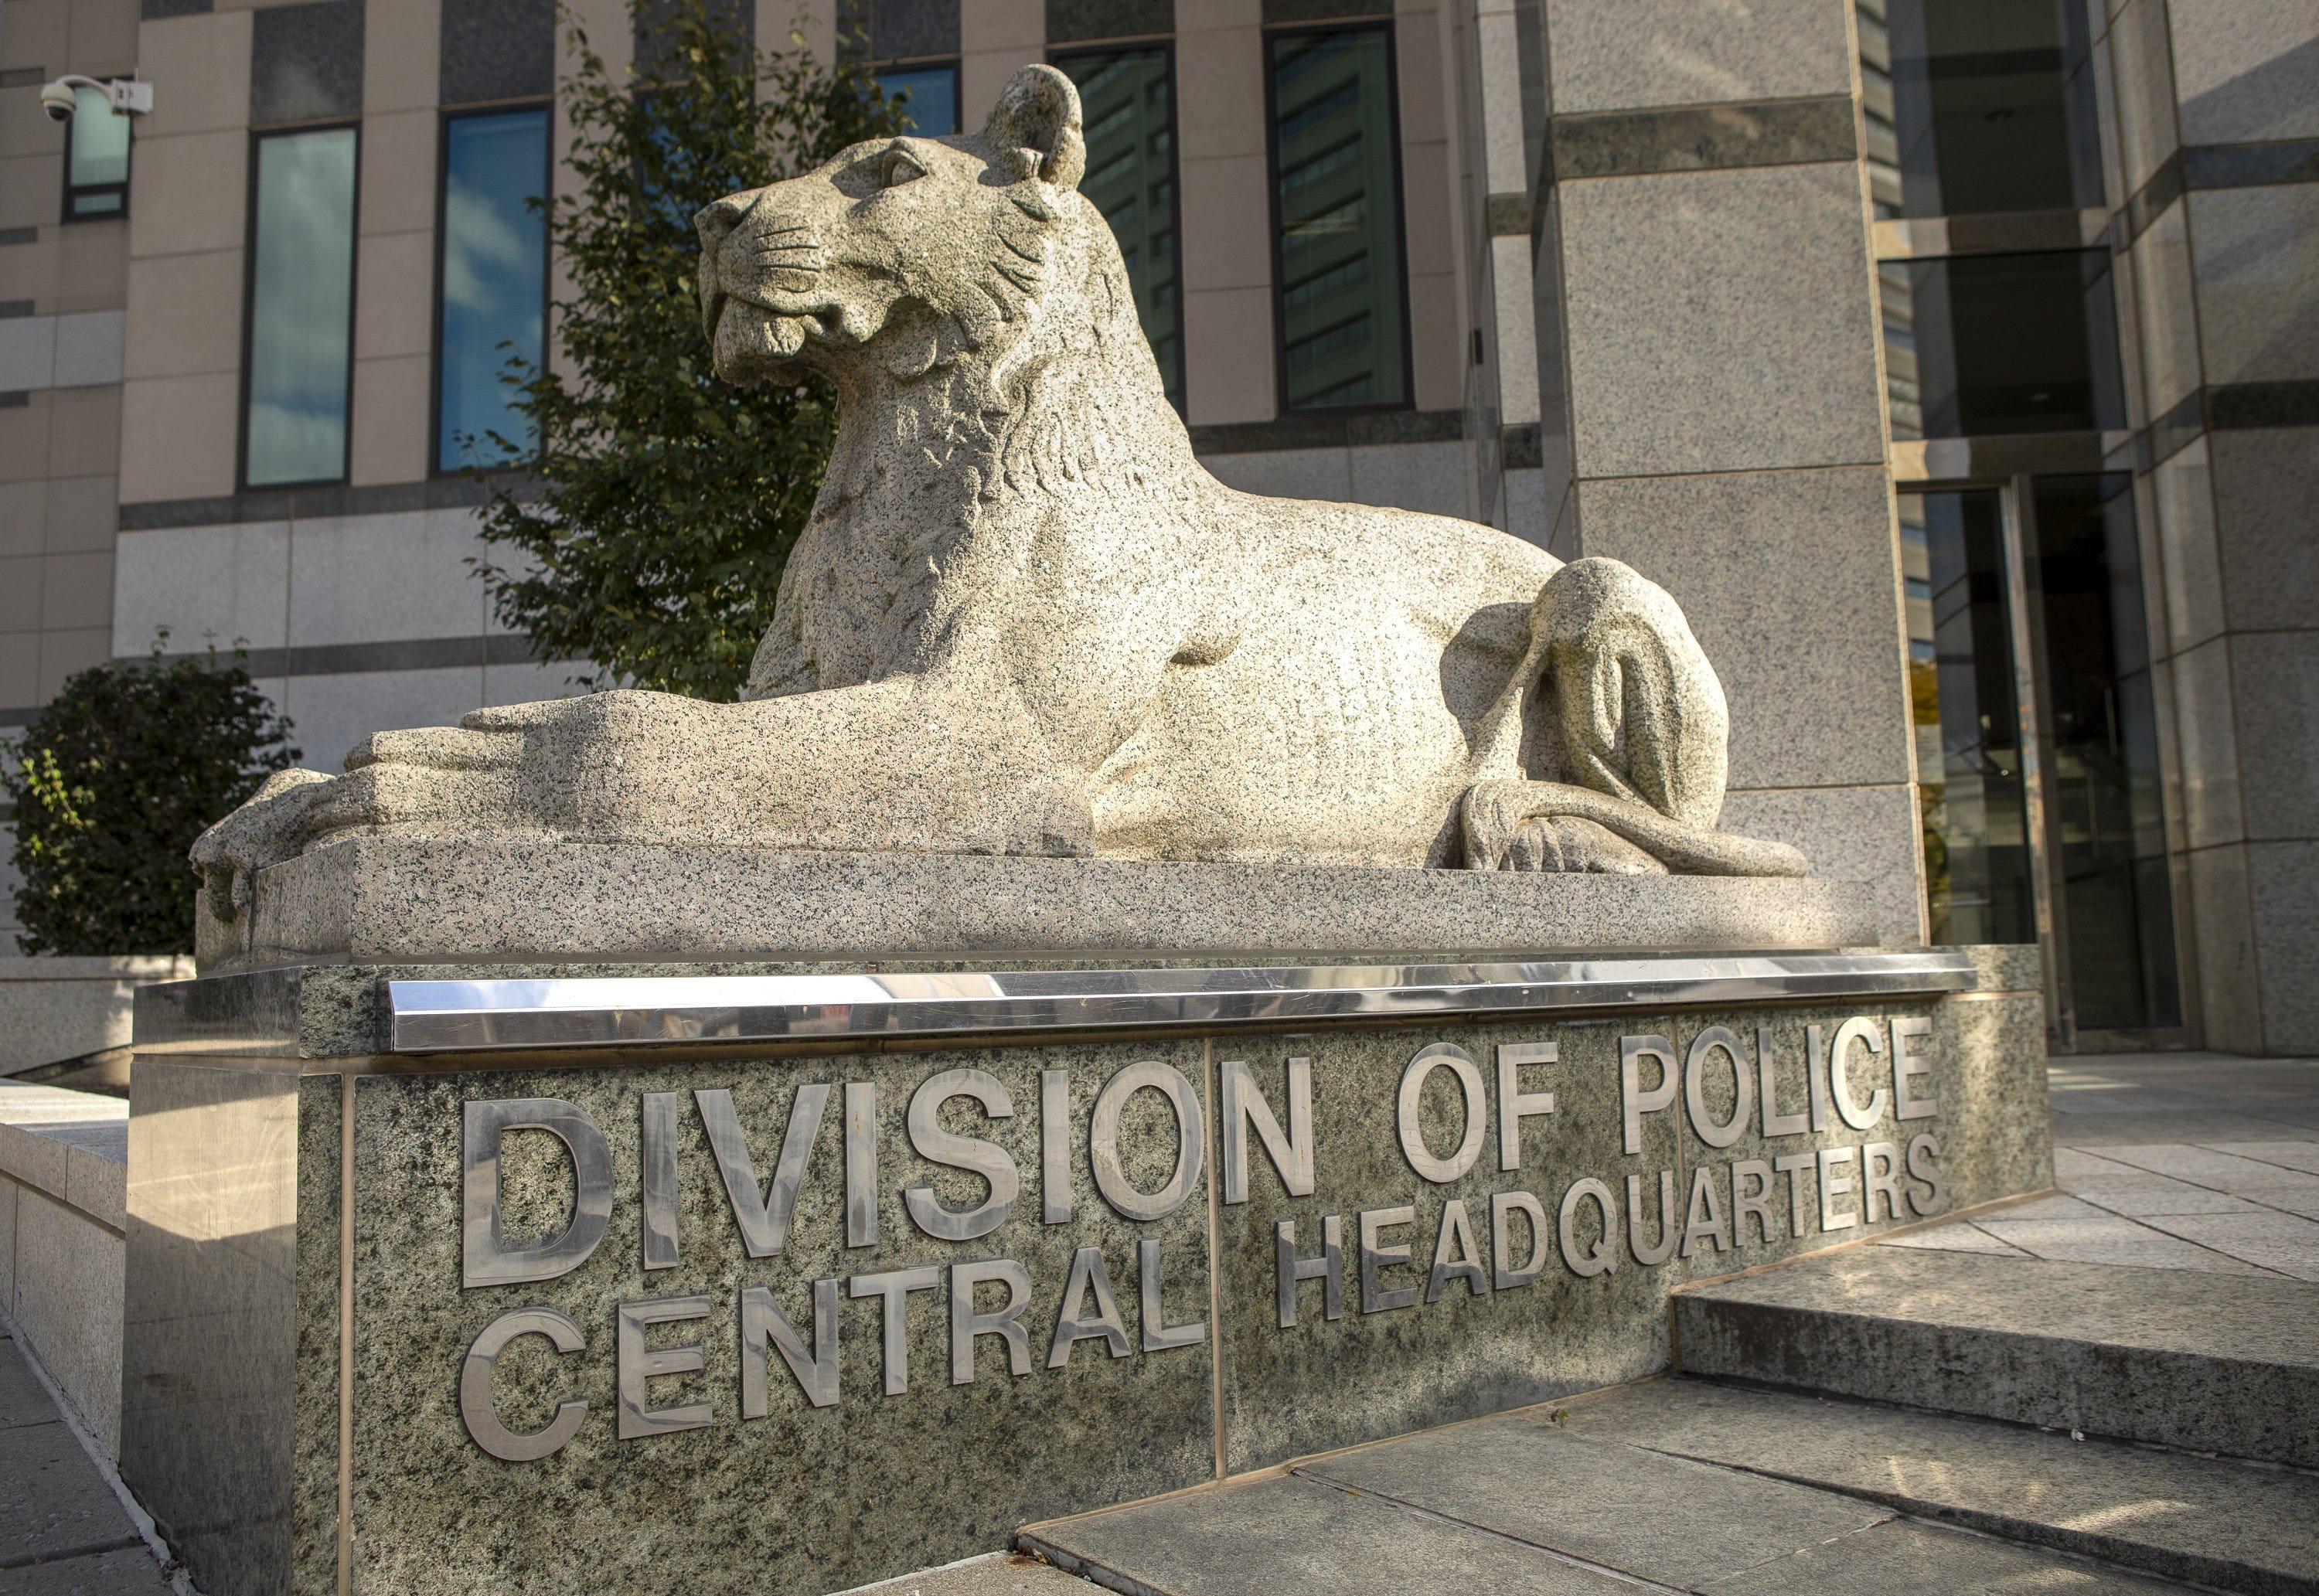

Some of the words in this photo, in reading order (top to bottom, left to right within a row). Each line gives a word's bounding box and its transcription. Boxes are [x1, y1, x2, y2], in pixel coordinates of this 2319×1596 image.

[461, 1238, 1205, 1462] CENTRAL
[1276, 1132, 1948, 1329] HEADQUARTERS
[463, 1056, 1315, 1288] DIVISION
[1398, 1041, 1558, 1184] OF
[1619, 1015, 1938, 1155] POLICE
